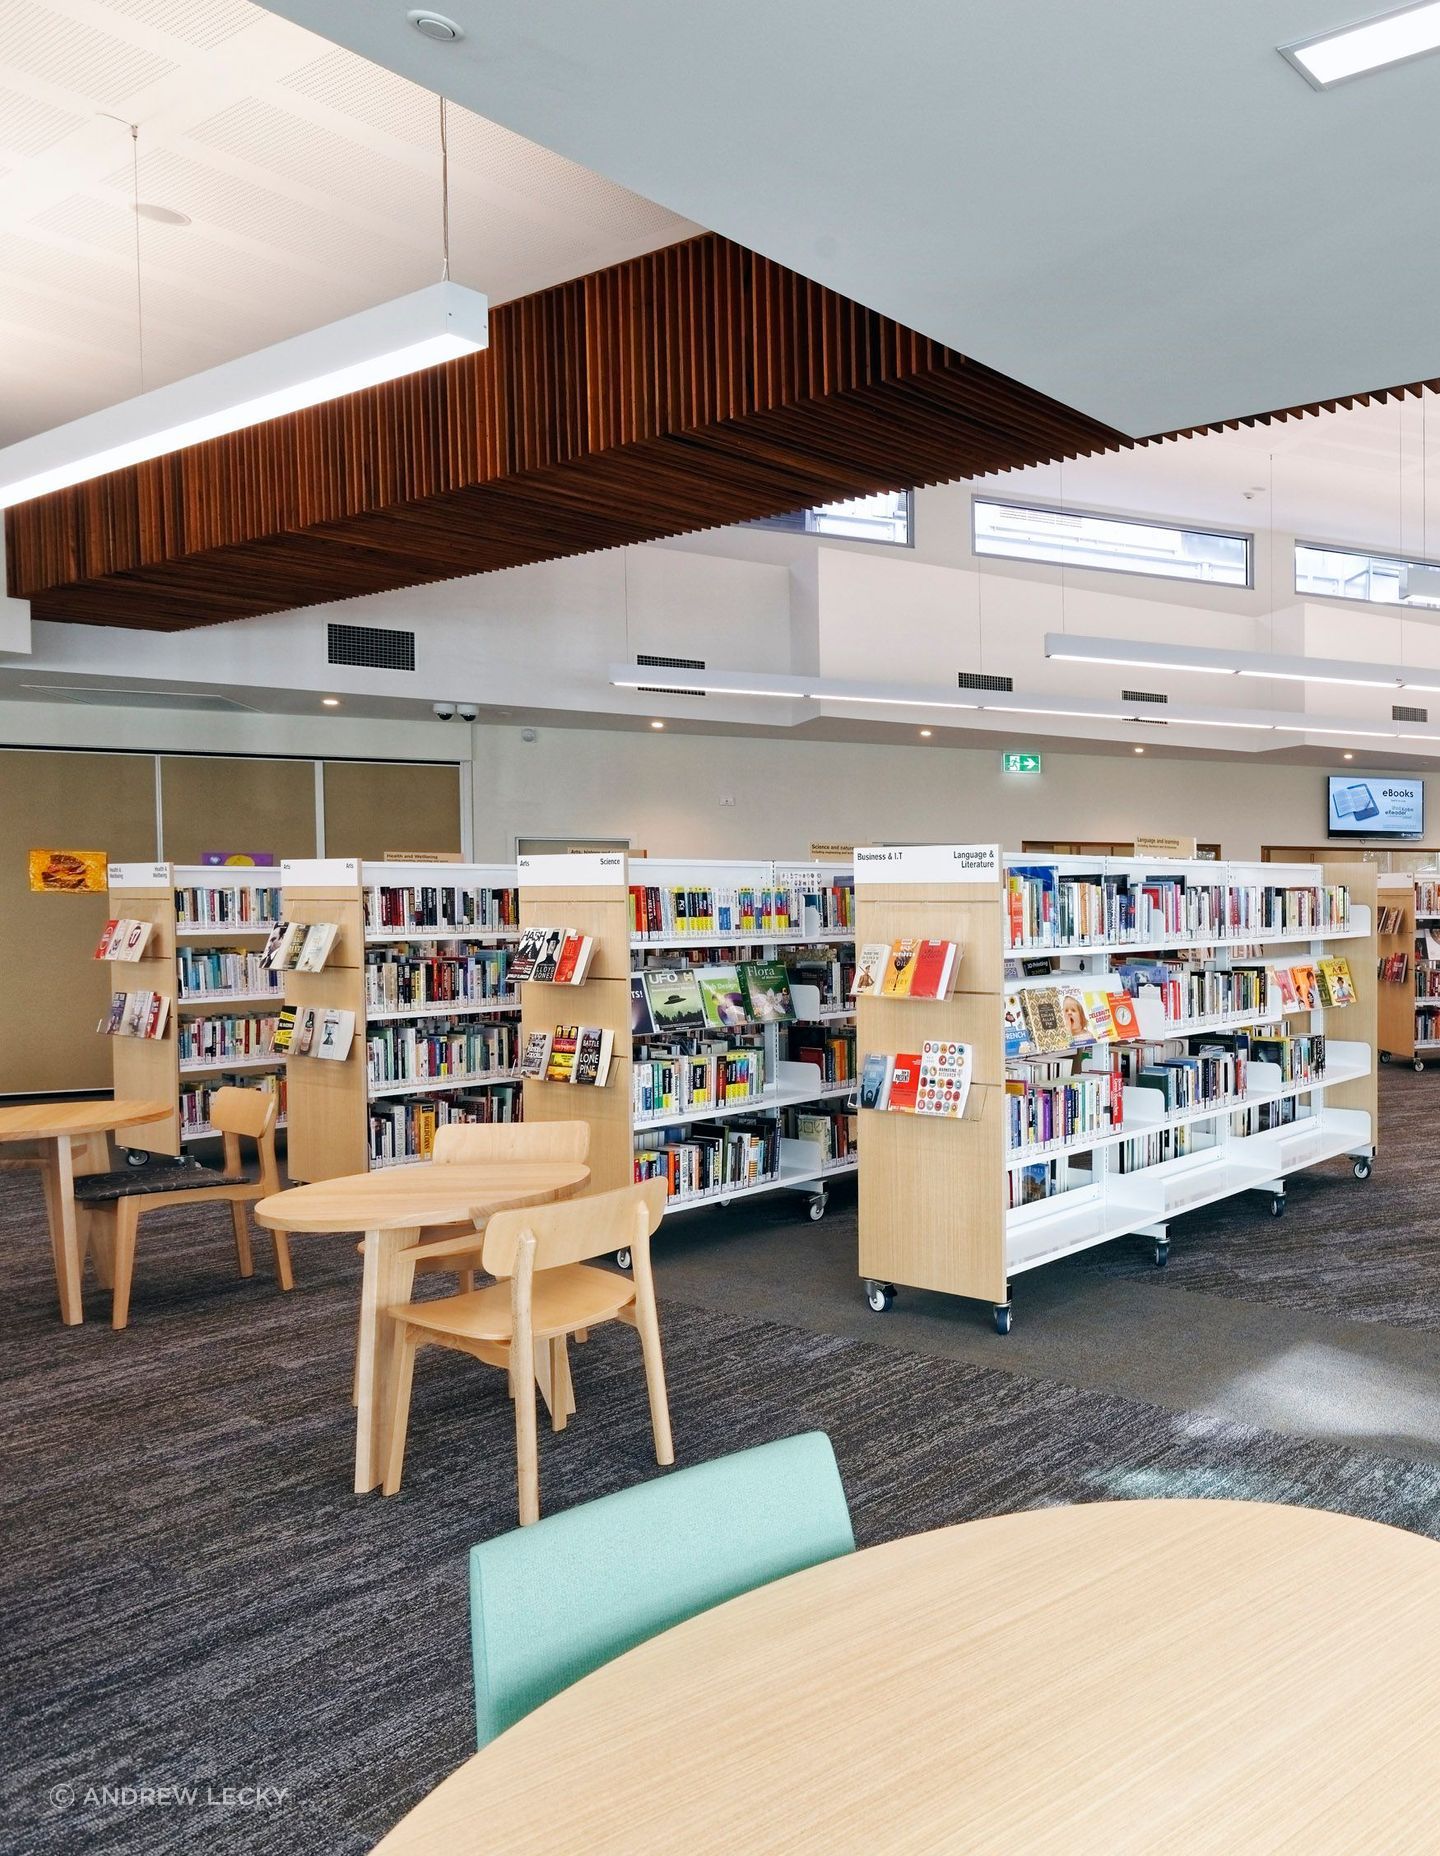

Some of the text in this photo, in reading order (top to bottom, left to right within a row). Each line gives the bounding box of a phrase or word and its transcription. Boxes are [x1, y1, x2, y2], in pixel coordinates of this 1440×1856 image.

[1382, 788, 1414, 798] eBooks
[857, 852, 902, 861] Business & I.T
[953, 850, 994, 861] Language &
[519, 859, 530, 868] Arts
[599, 857, 620, 866] Science
[961, 859, 994, 869] Literature
[748, 966, 775, 978] Flora
[649, 973, 678, 985] UFO
[582, 1040, 600, 1048] BATTLE
[580, 1053, 599, 1064] LONE
